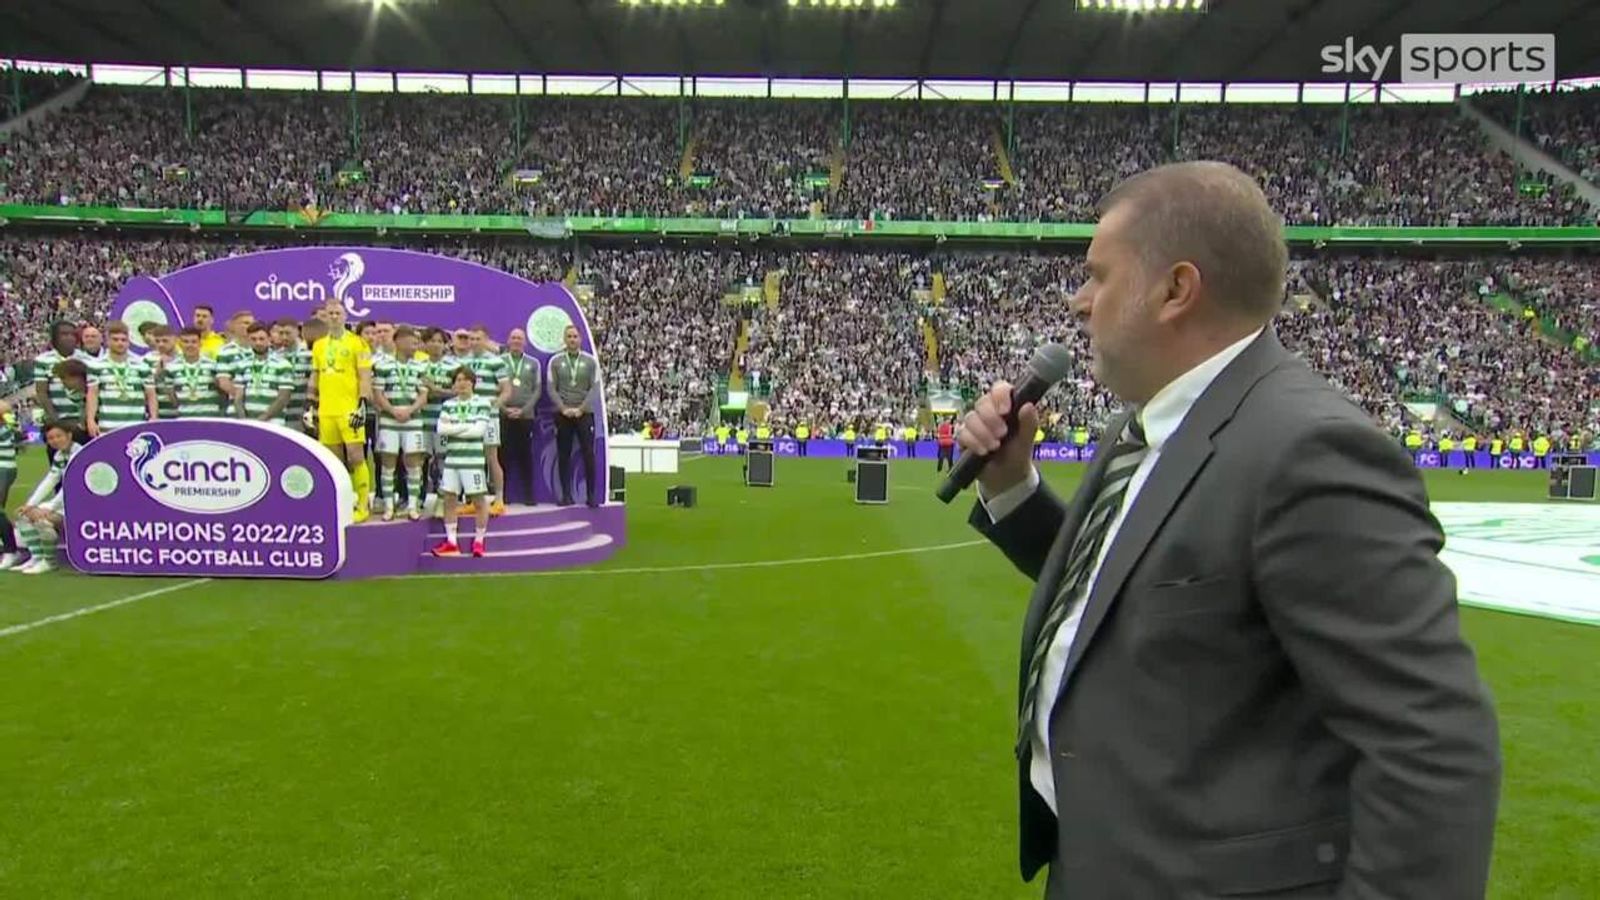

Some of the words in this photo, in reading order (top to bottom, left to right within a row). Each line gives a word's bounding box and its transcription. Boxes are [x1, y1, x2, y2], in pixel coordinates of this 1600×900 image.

[255, 274, 325, 301] cinch
[364, 287, 452, 300] PREMIERSHIP
[163, 451, 250, 482] cinch
[174, 487, 241, 497] PREMIERSHIP
[80, 521, 226, 542] CHAMPIONS
[232, 523, 325, 544] 2022/23
[84, 548, 153, 564] CELTIC
[158, 550, 264, 566] FOOTBALL
[269, 551, 324, 567] CLUB
